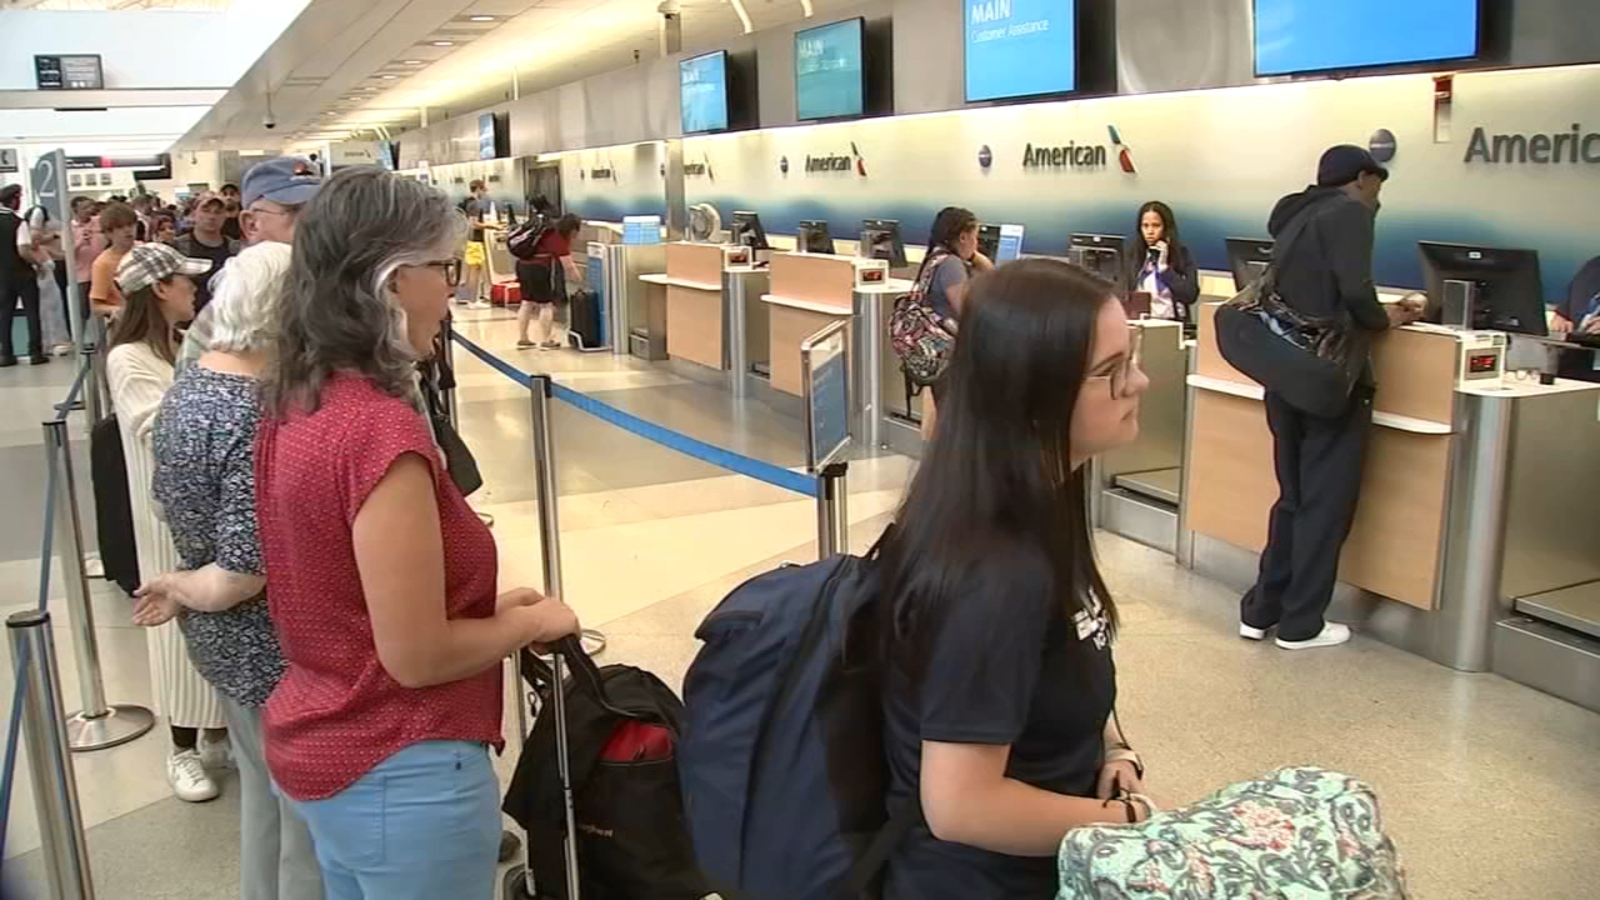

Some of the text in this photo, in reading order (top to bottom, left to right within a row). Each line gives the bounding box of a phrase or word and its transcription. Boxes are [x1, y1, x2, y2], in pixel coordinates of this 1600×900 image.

[971, 0, 1011, 24] MAIN
[804, 152, 851, 173] American
[1022, 141, 1106, 169] American
[37, 160, 56, 197] 2
